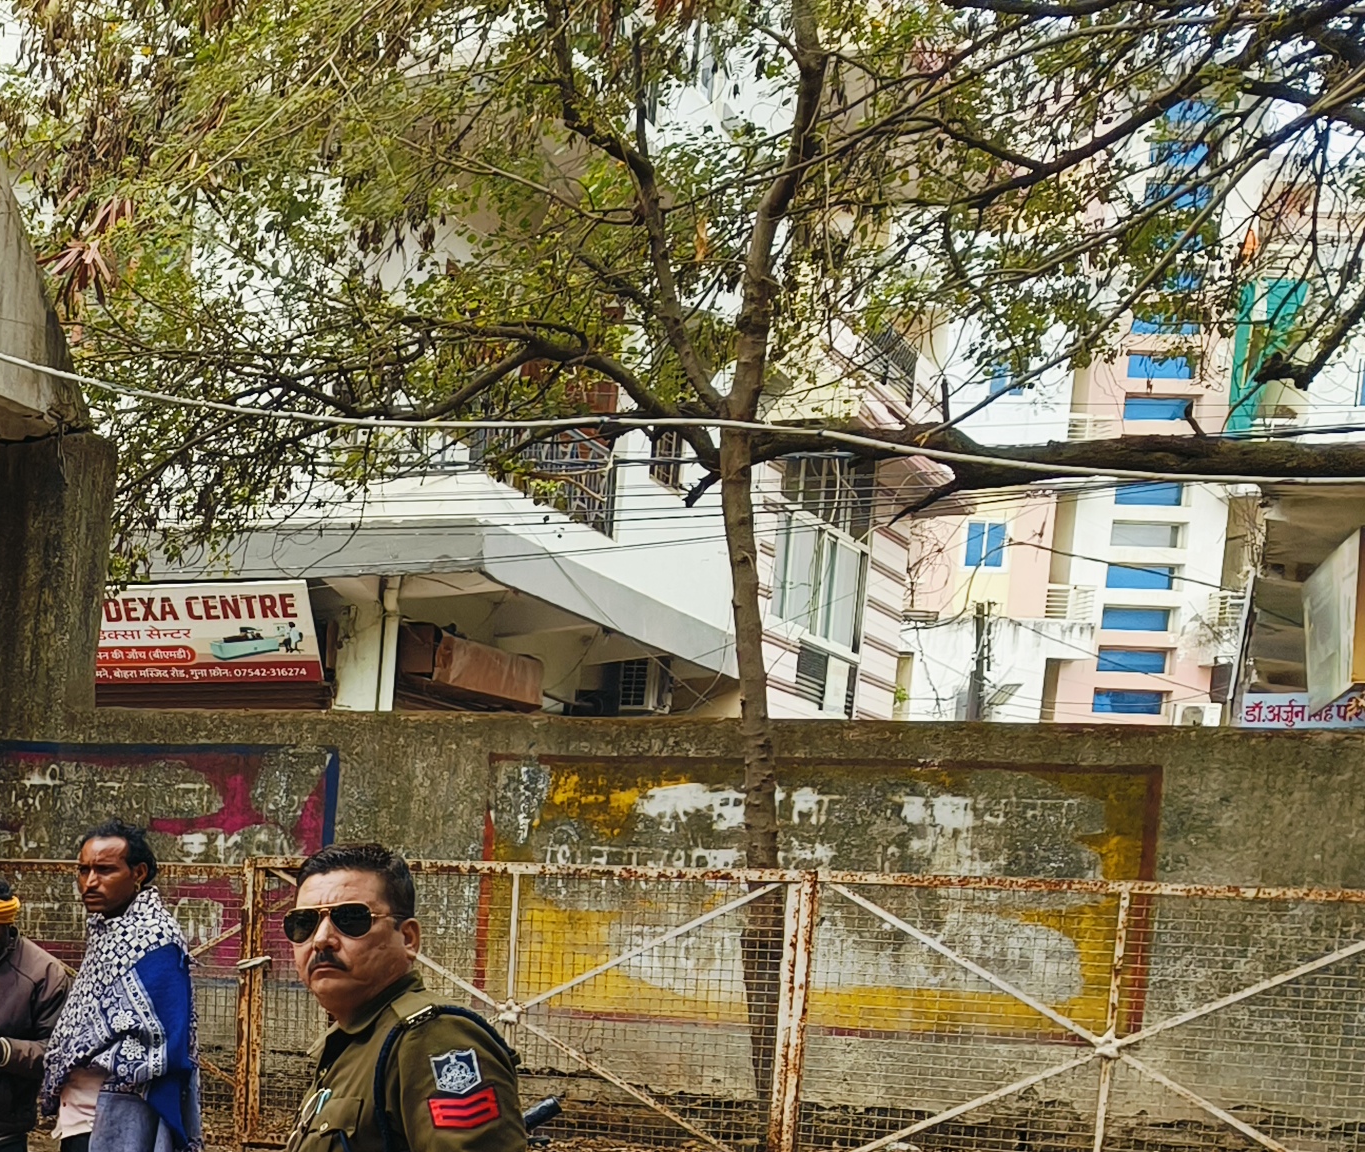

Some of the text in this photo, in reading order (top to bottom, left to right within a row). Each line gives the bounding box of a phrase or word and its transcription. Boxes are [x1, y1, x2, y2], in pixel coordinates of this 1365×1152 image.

[103, 593, 298, 622] DEXA CENTRE
[145, 625, 191, 639] सेन्टर
[110, 649, 124, 660] की
[149, 649, 192, 661] (बीएमडी)
[113, 667, 137, 678] बोहरा
[139, 668, 169, 678] मस्जिद
[190, 669, 207, 679] गुना
[234, 667, 307, 677] 07542-316274
